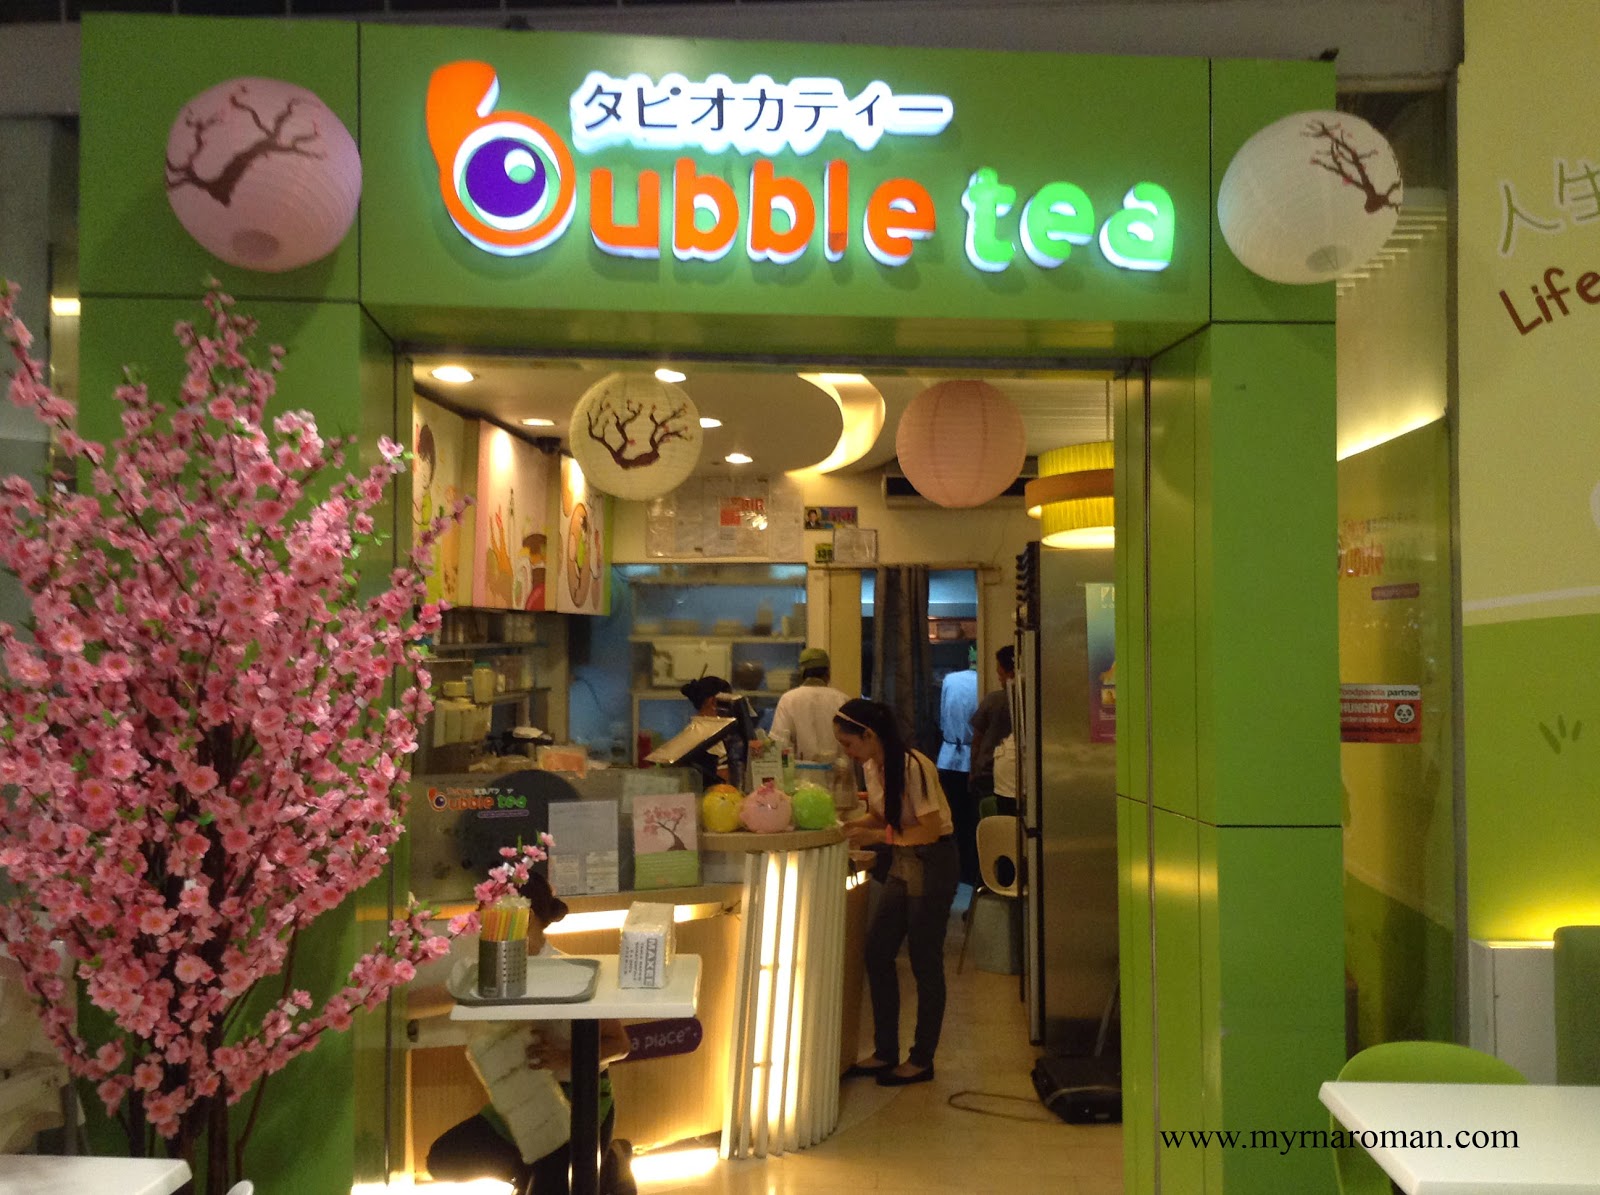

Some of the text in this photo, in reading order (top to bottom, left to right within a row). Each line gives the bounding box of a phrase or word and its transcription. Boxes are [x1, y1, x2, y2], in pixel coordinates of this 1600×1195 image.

[581, 83, 944, 132] タピオカティー
[961, 166, 1176, 271] tea
[1499, 267, 1600, 336] Life
[1387, 689, 1419, 697] partner
